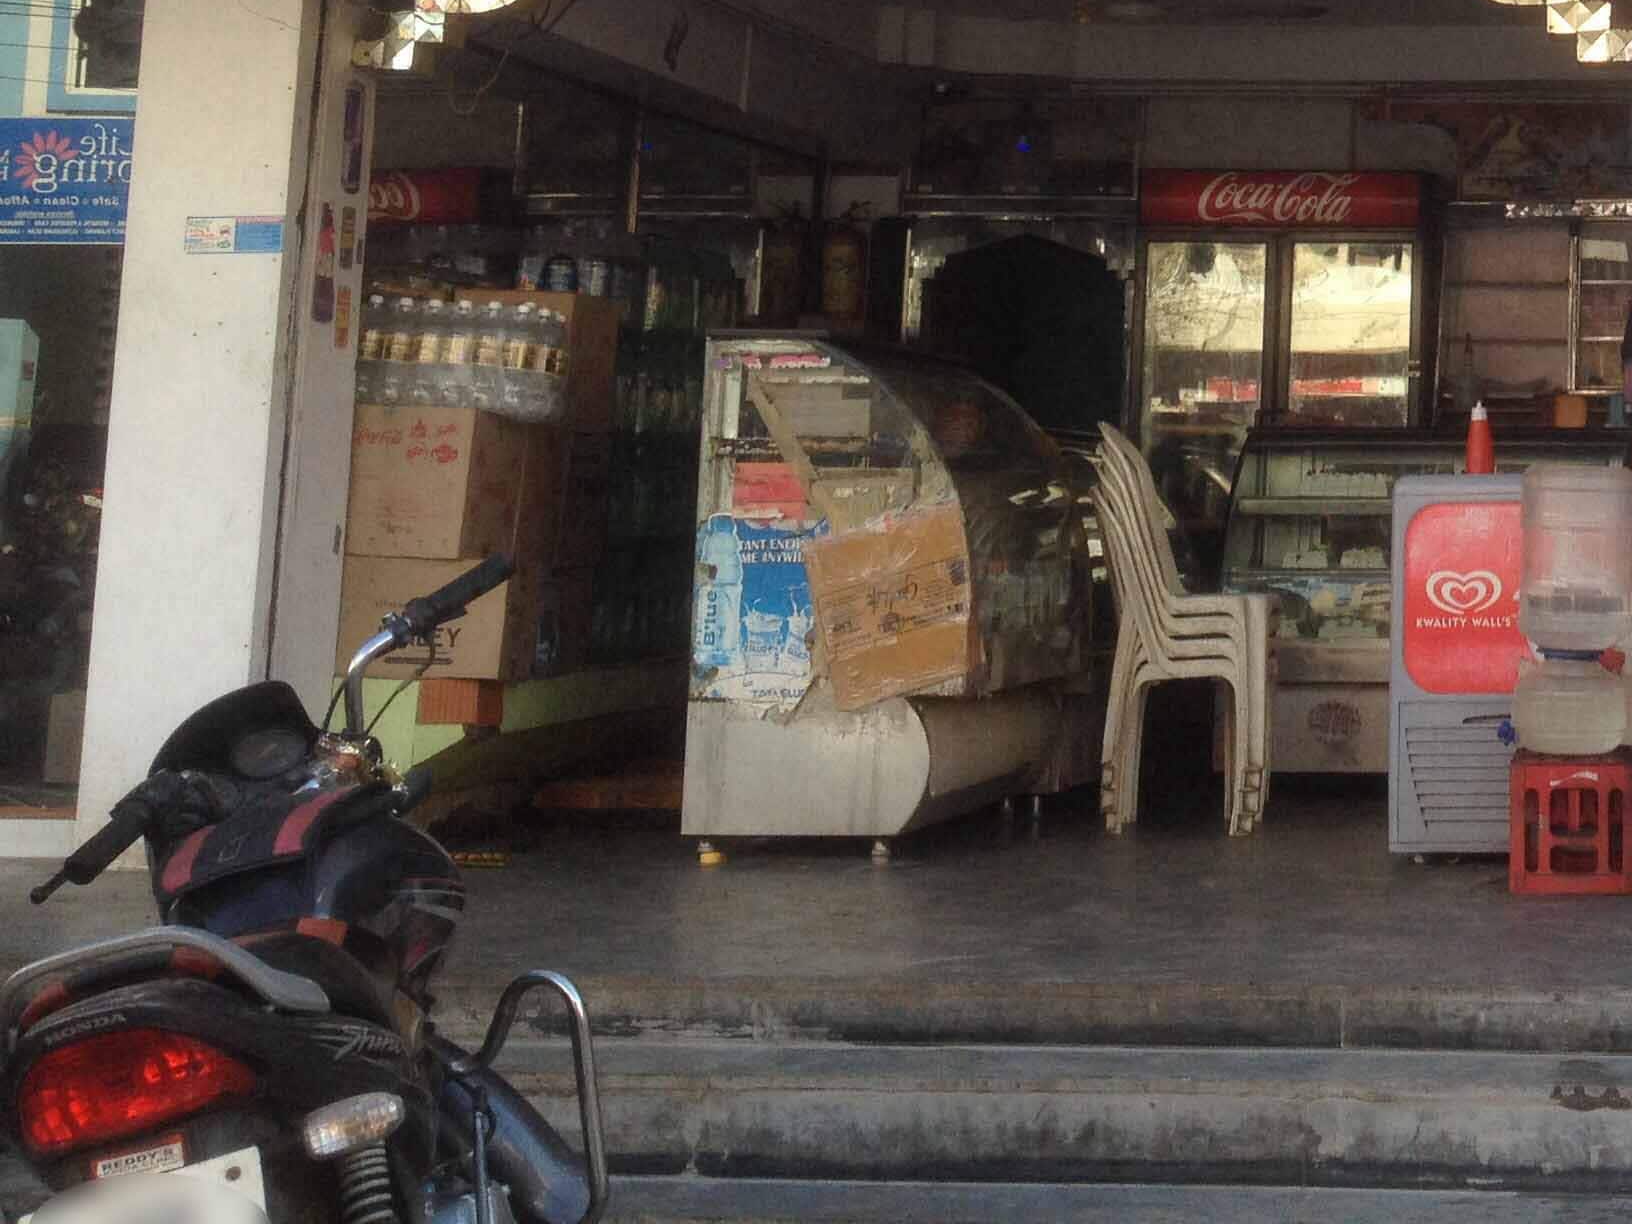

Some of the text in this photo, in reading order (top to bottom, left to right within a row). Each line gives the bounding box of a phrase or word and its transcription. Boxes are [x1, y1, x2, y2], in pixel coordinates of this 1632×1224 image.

[1197, 171, 1361, 223] Coca-Cola
[1416, 616, 1511, 628] KWALITY WALL'S
